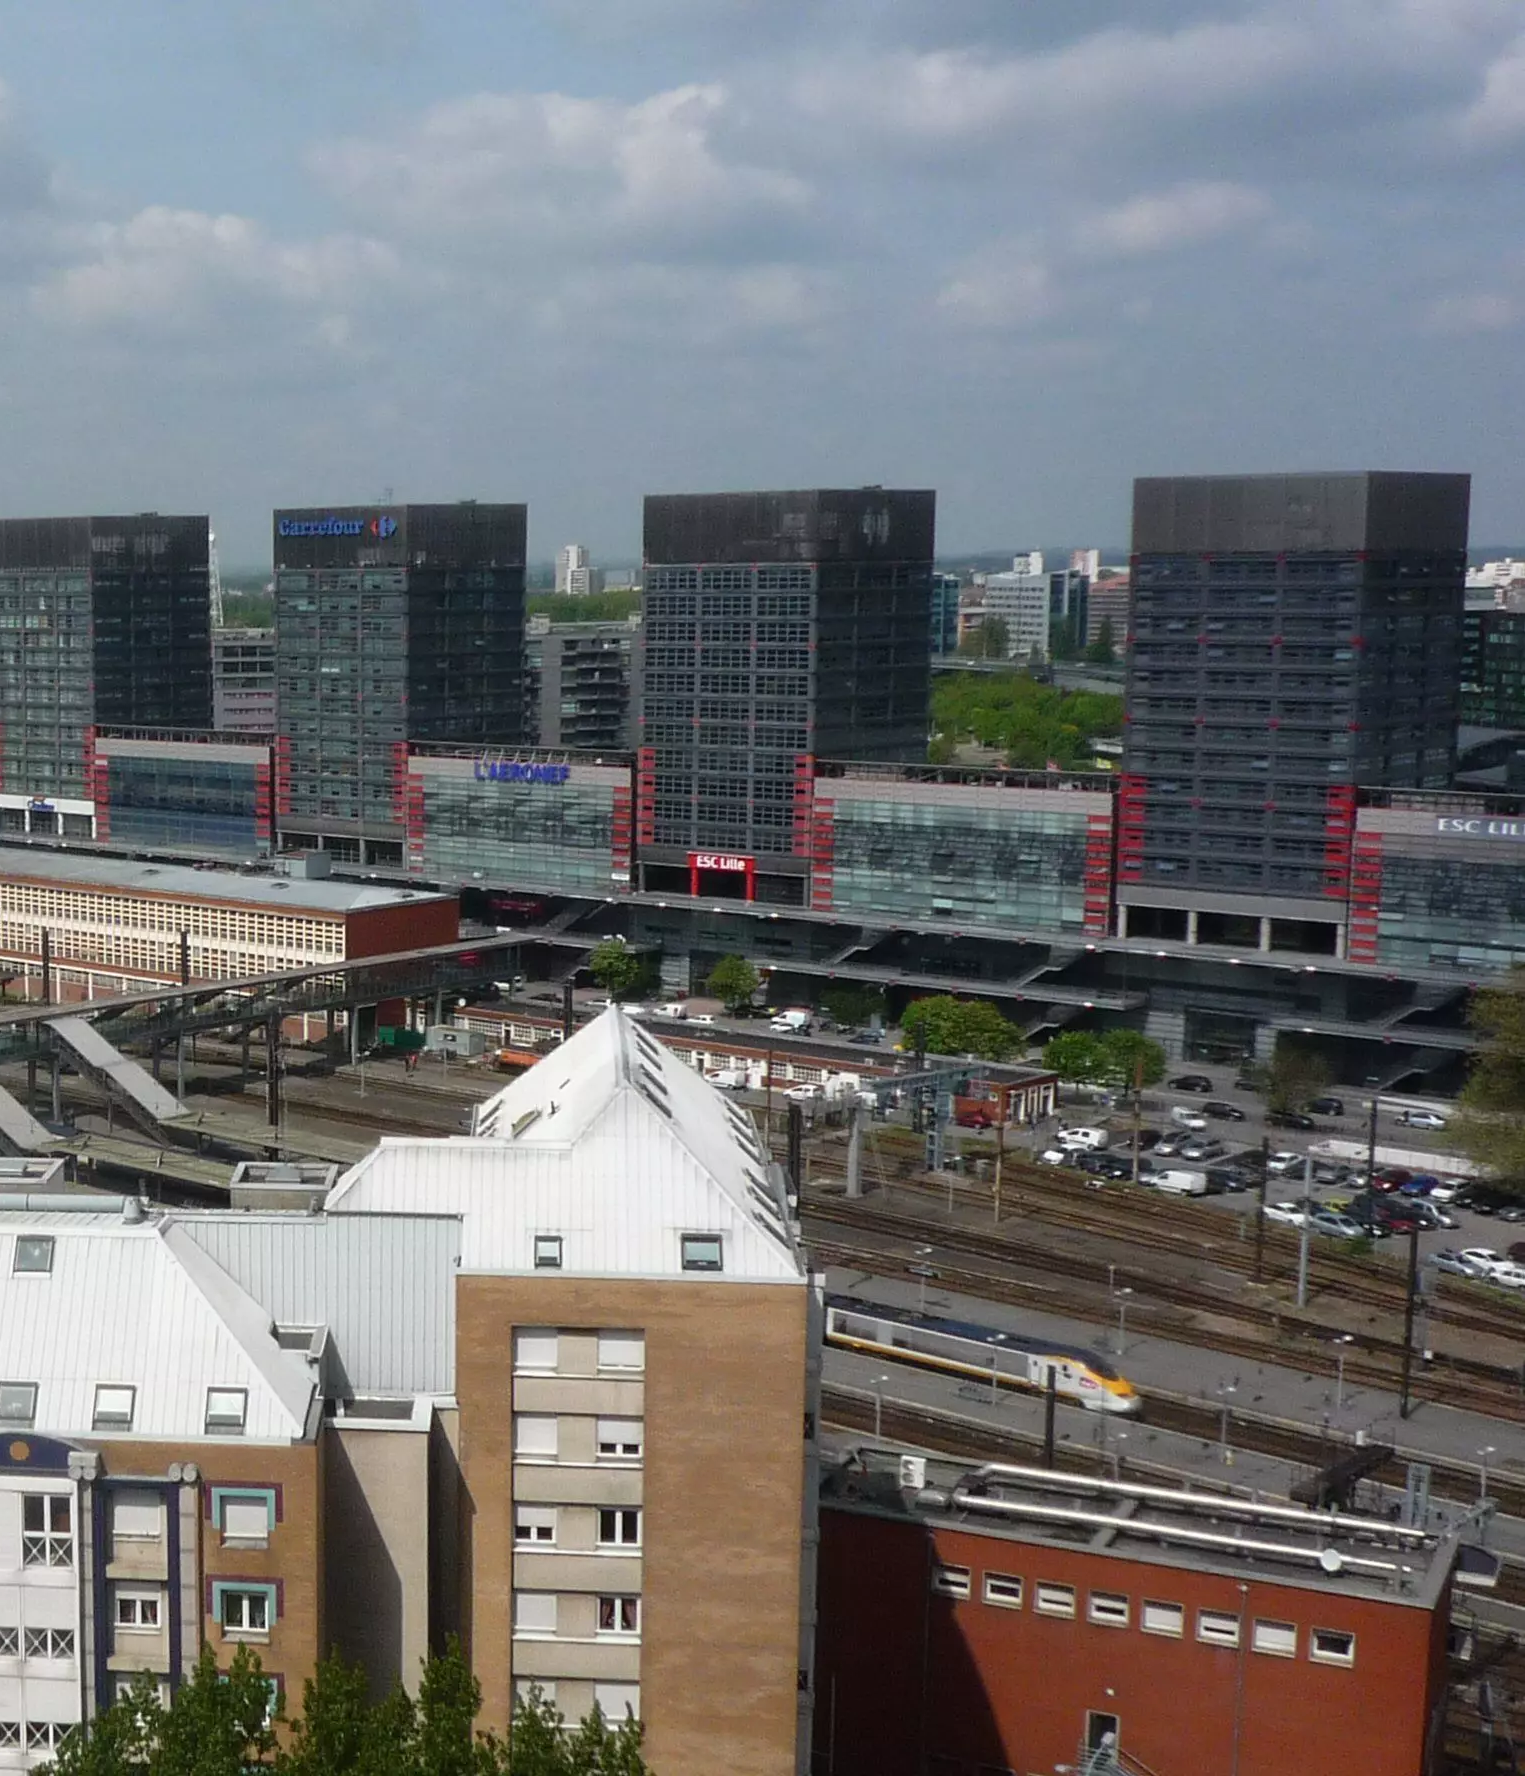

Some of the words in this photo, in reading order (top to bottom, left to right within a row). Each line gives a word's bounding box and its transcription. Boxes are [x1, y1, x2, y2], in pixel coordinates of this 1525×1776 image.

[278, 517, 364, 536] Carrefour
[1438, 818, 1481, 833] ESC
[696, 855, 719, 868] ESC
[720, 857, 746, 871] Lille
